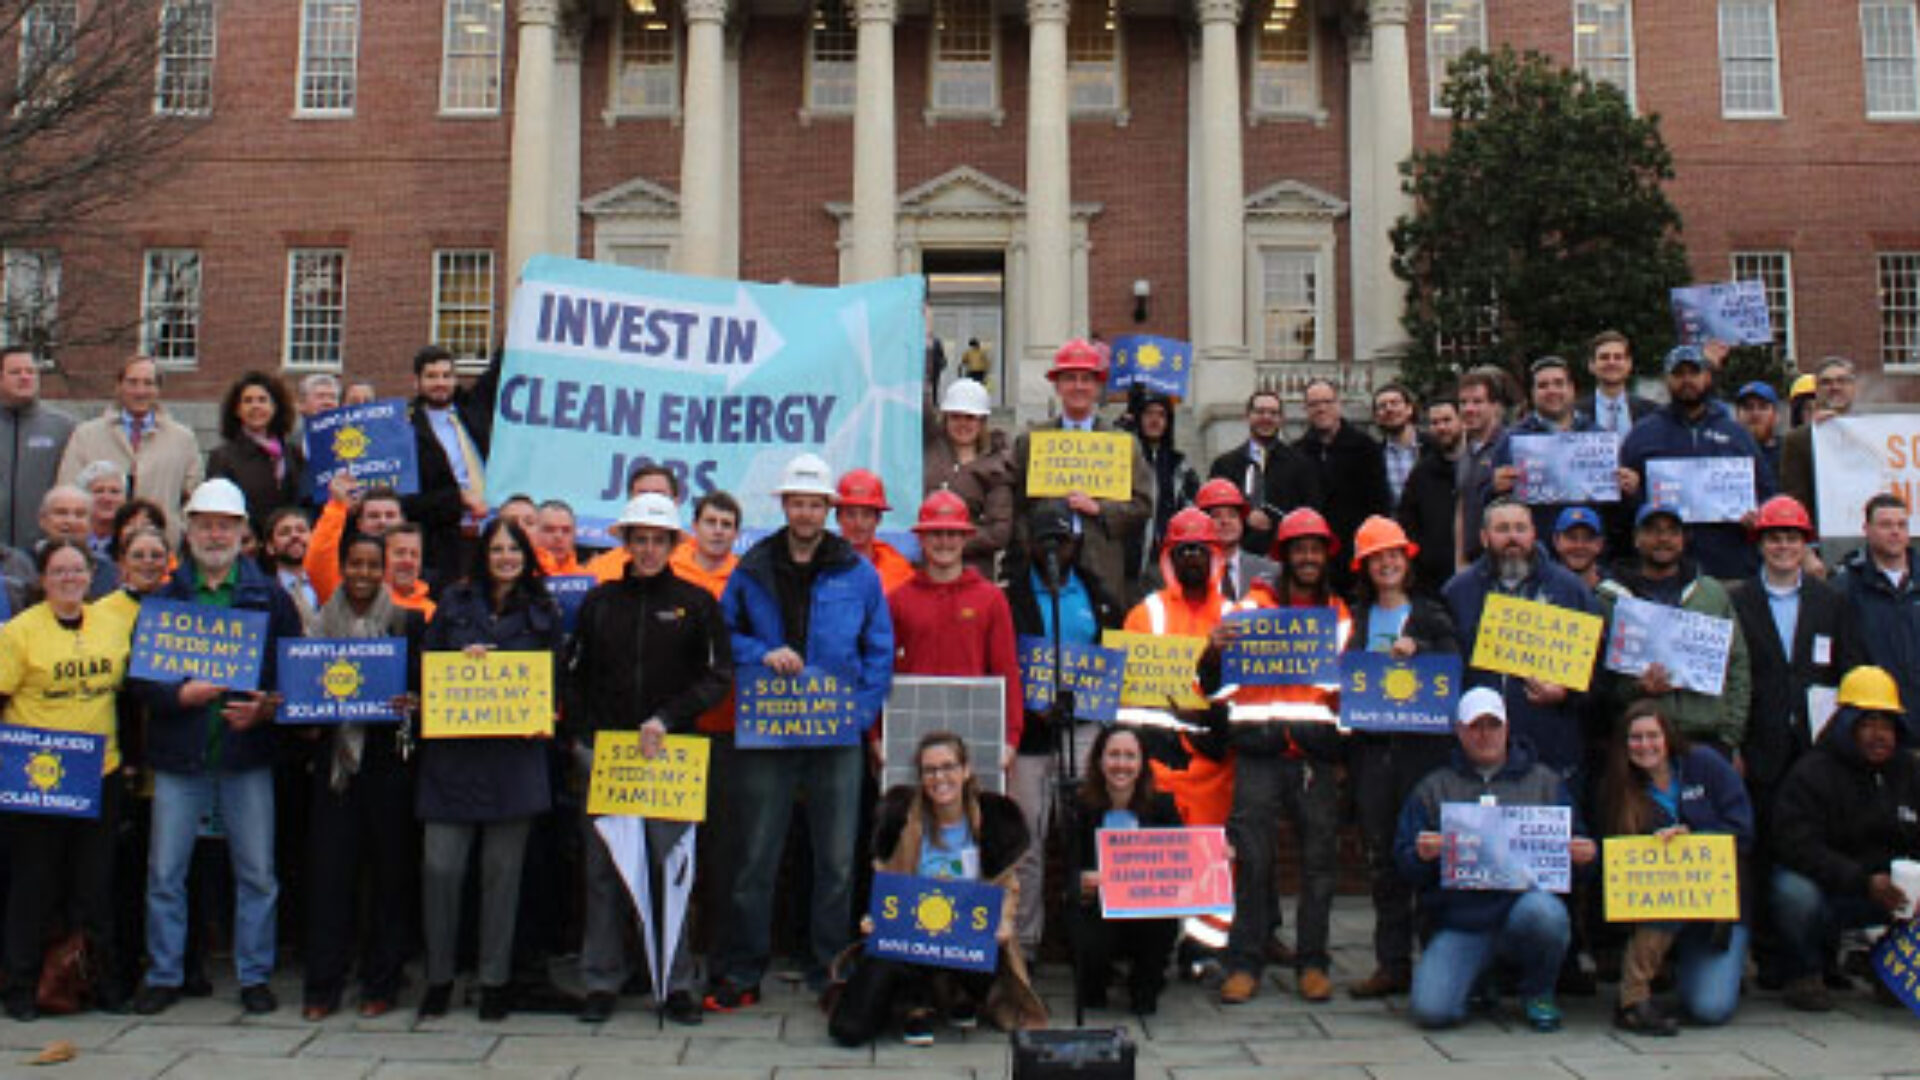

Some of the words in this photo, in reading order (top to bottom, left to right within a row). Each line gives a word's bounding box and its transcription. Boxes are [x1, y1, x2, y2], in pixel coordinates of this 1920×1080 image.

[536, 292, 699, 361] INVEST
[705, 315, 758, 364] IN
[499, 374, 646, 438] CLEAN
[657, 393, 837, 444] ENERGY
[1047, 439, 1114, 455] SOLAR
[1045, 471, 1113, 488] FAMILY
[159, 611, 244, 638] SOLAR
[1241, 617, 1320, 635] SOLAR
[1501, 607, 1579, 637] SOLAR
[154, 632, 210, 651] FEEDS
[212, 640, 242, 657] MY
[151, 653, 239, 678] FAMILY
[1241, 658, 1320, 674] FAMILY
[1494, 643, 1572, 675] FAMILY
[54, 658, 113, 681] SOLAR
[445, 664, 531, 682] SOLAR
[444, 686, 498, 700] FEEDS
[755, 676, 838, 696] SOLAR
[445, 706, 532, 725] FAMILY
[755, 718, 840, 736] FAMILY
[611, 744, 688, 764] SOAR
[608, 785, 687, 807] FAMILY
[1625, 846, 1713, 865] SOLAR
[1626, 889, 1714, 907] FAMILY
